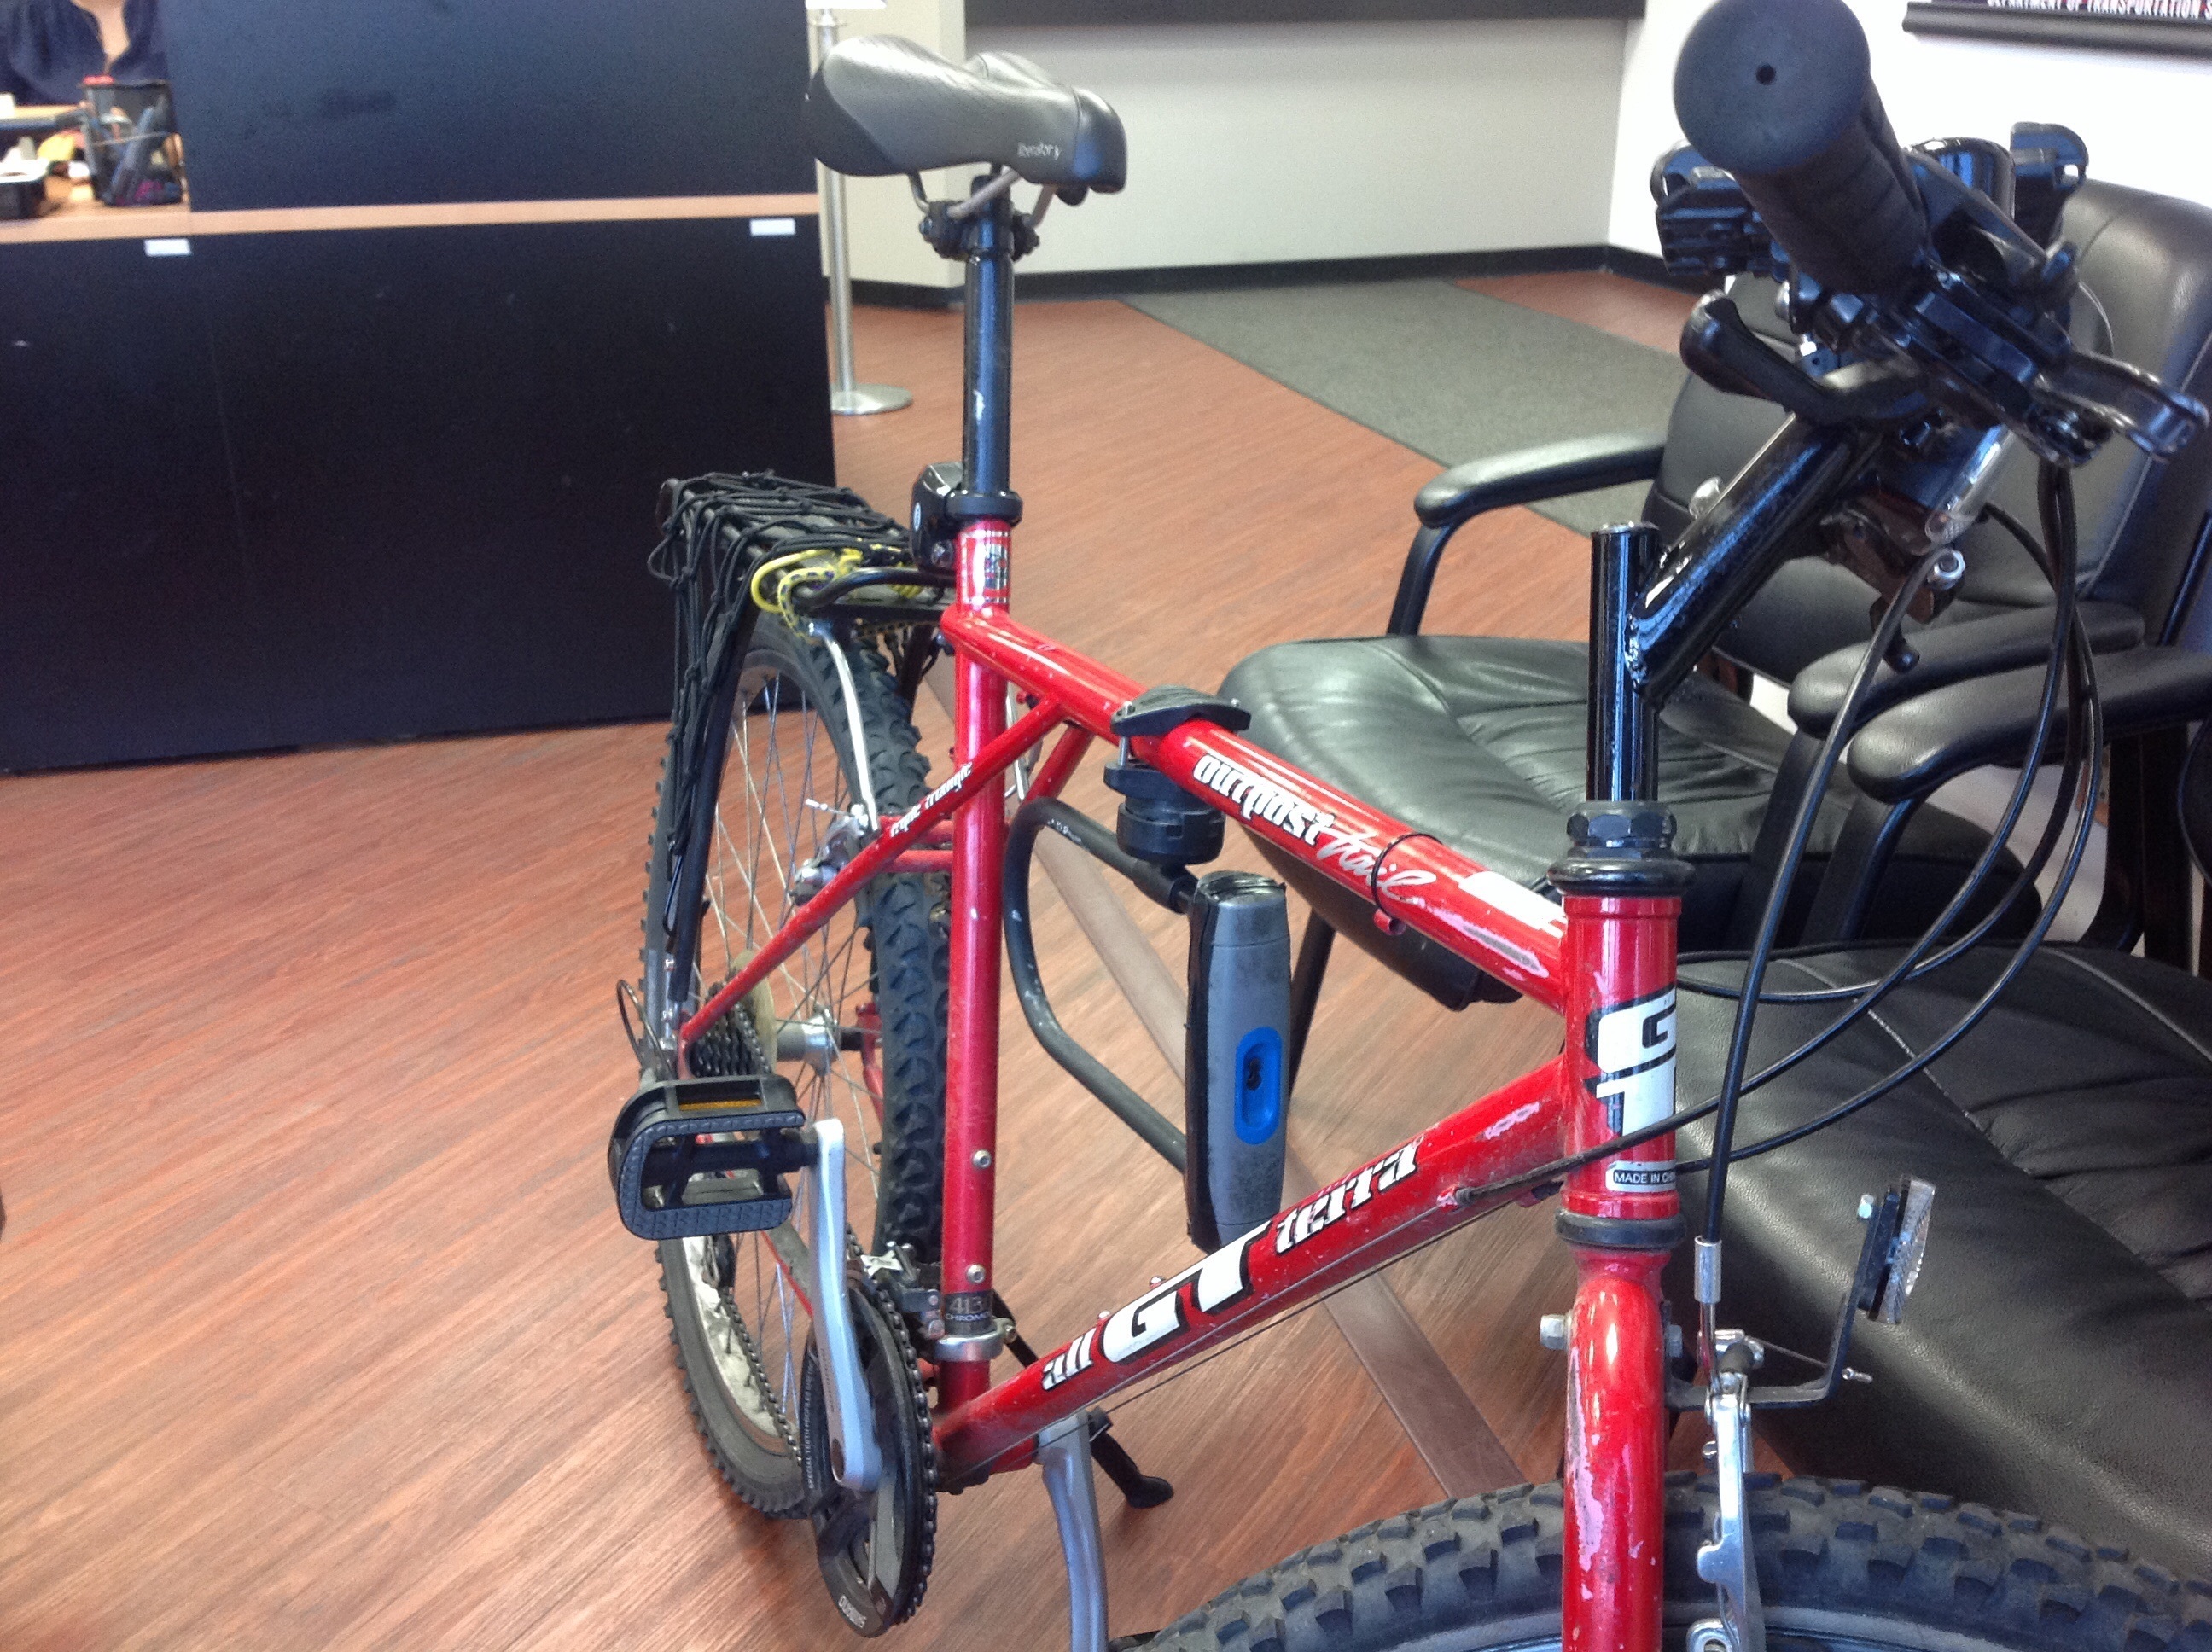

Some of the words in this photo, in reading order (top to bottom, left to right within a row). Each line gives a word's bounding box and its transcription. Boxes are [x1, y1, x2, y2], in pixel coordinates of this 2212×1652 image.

[2086, 0, 2200, 19] TRANSPORTATION
[1615, 1172, 1648, 1184] MADE
[1650, 1173, 1661, 1184] IN
[1099, 1219, 1272, 1365] GT
[1275, 1139, 1421, 1254] terra
